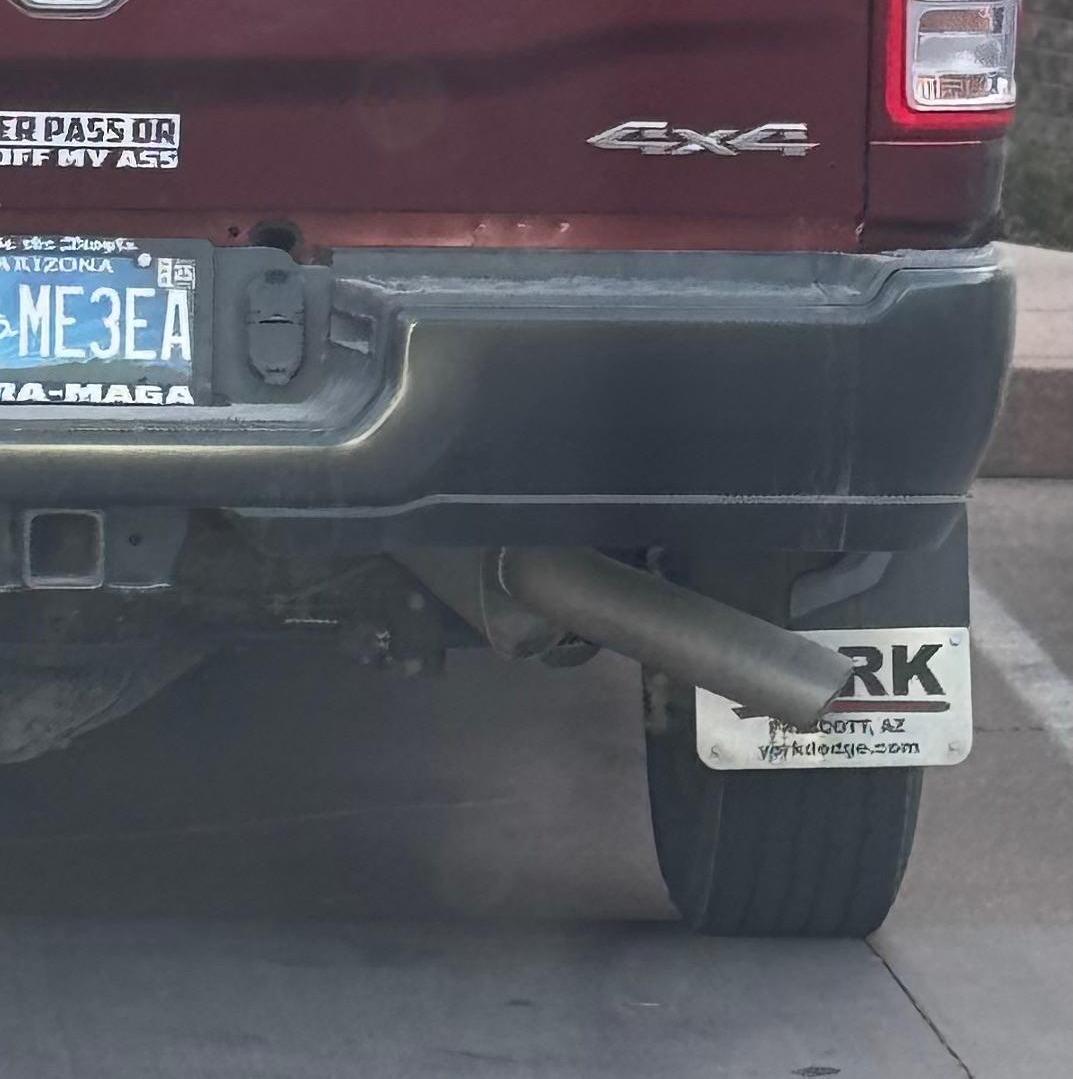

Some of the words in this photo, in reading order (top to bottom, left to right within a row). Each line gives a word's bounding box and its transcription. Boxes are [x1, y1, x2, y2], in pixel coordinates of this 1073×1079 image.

[43, 115, 126, 144] PASS
[131, 117, 176, 145] OR
[57, 148, 113, 168] MY
[115, 148, 179, 169] ASS
[19, 284, 193, 362] ME3EA
[836, 643, 947, 698] RK
[880, 717, 907, 734] AZ
